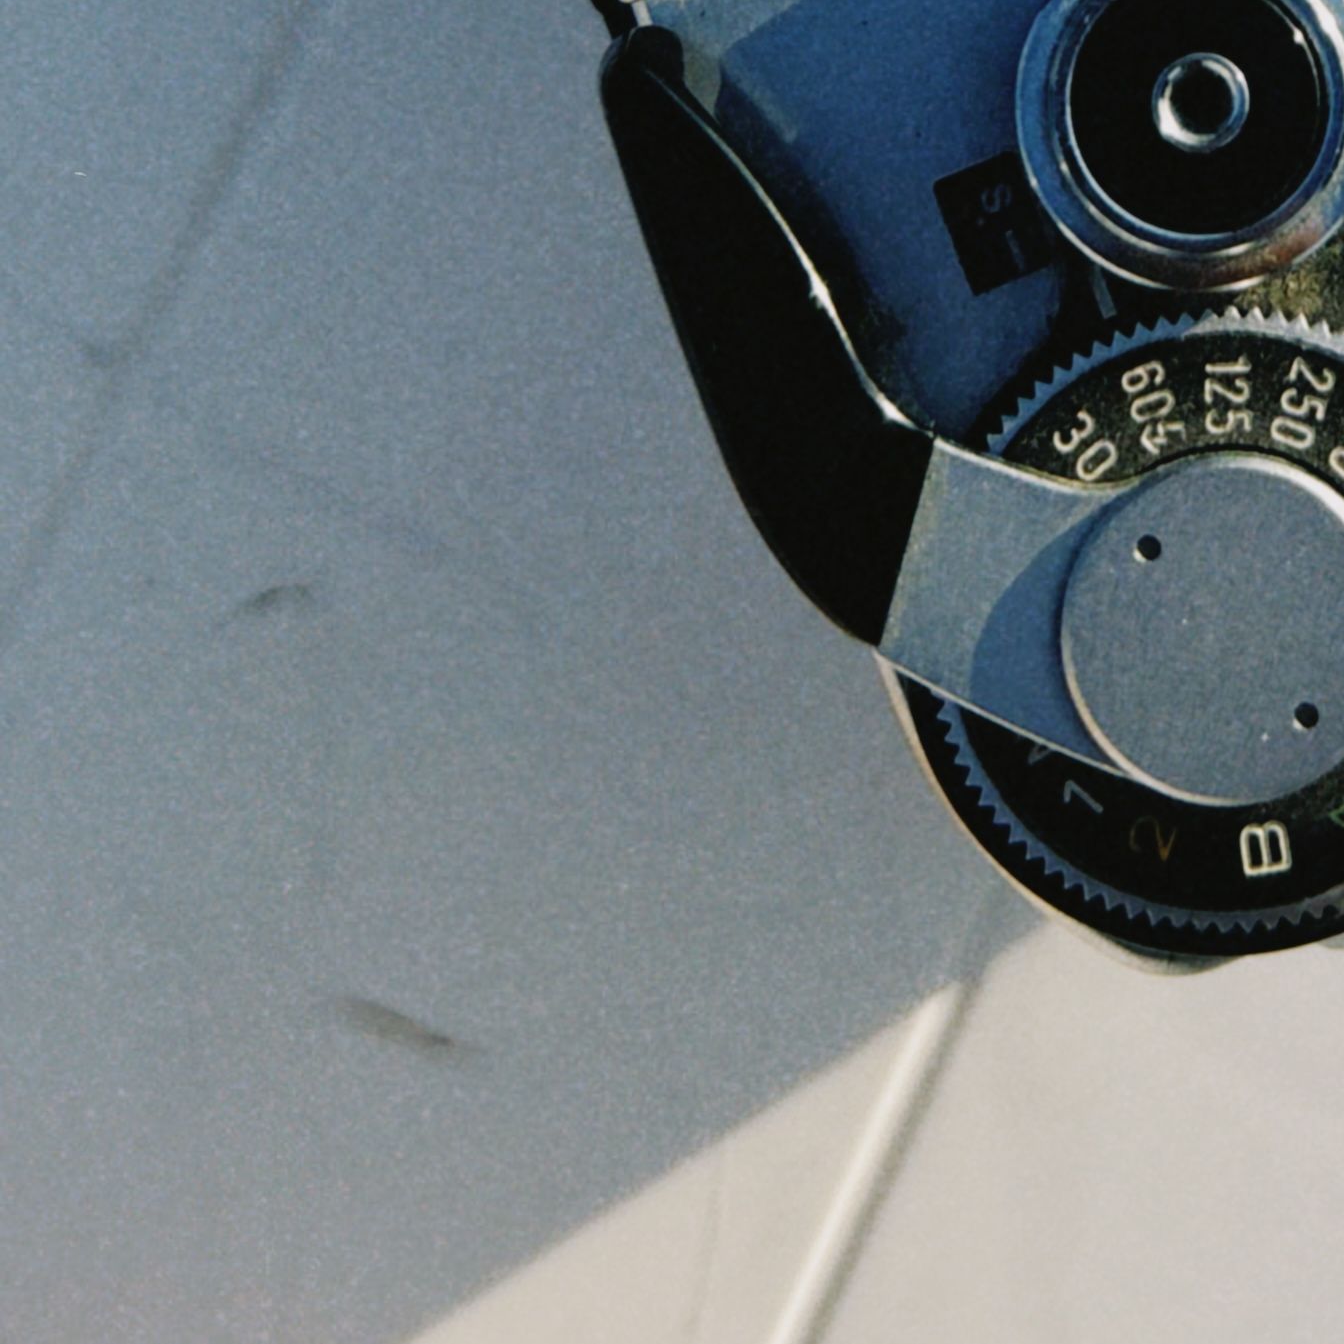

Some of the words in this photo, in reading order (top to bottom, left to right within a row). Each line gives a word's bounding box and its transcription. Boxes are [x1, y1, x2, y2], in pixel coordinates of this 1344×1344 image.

[1053, 410, 1118, 481] 30
[1204, 356, 1252, 434] 125
[1272, 356, 1335, 450] 250
[1240, 820, 1292, 878] B
